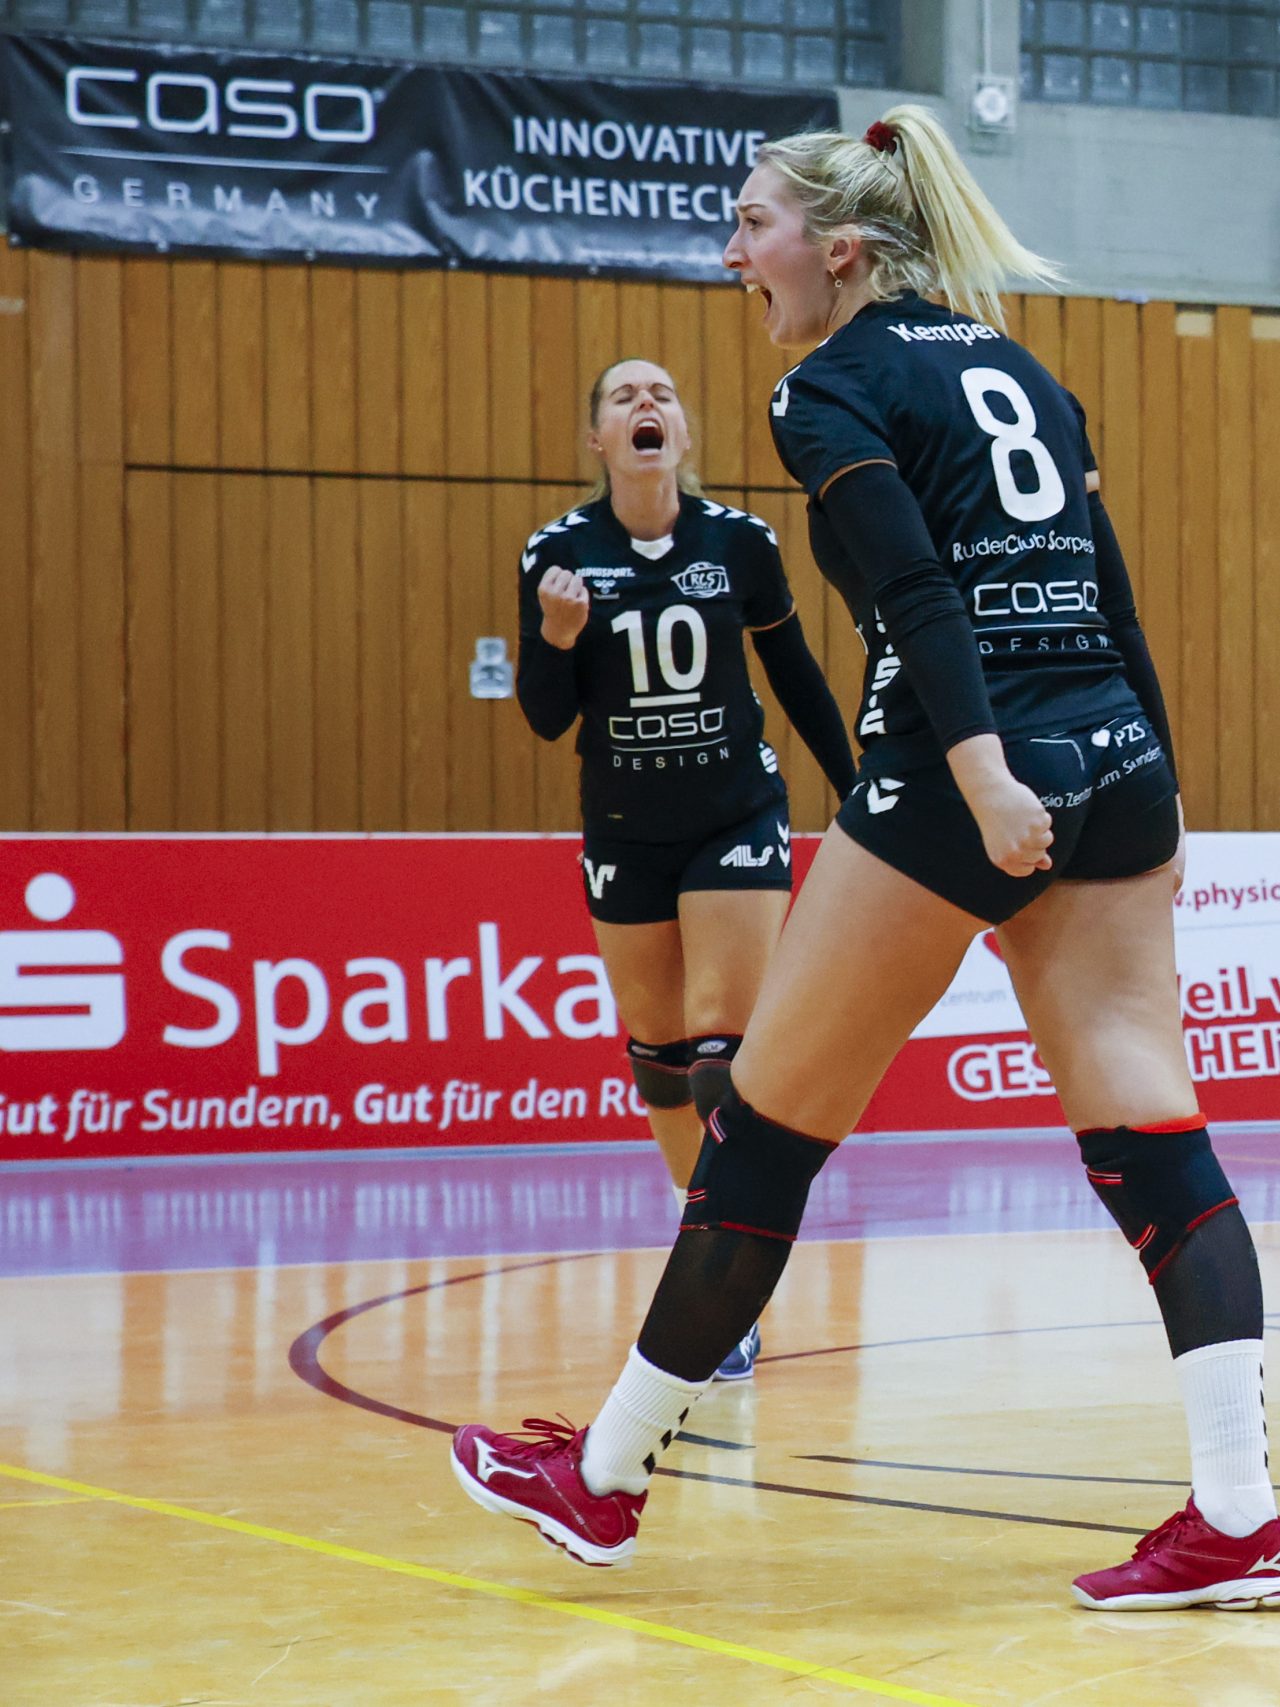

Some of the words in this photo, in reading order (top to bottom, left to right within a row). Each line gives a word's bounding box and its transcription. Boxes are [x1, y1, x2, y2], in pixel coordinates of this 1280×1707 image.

[512, 115, 767, 168] INNOVATIVE
[72, 174, 379, 220] GERMANY
[886, 322, 1001, 347] Kemper
[960, 366, 1066, 523] 8
[610, 604, 708, 694] 10
[612, 746, 730, 771] DESIGN
[1112, 721, 1146, 748] PZS
[719, 844, 775, 868] ALS
[159, 920, 620, 1077] Sparka
[1177, 965, 1252, 1015] eil
[0, 1093, 58, 1135] ut
[63, 1087, 133, 1143] für
[140, 1084, 342, 1132] Sundern,
[353, 1082, 435, 1125] Gut
[437, 1079, 504, 1131] für
[510, 1077, 589, 1120] den
